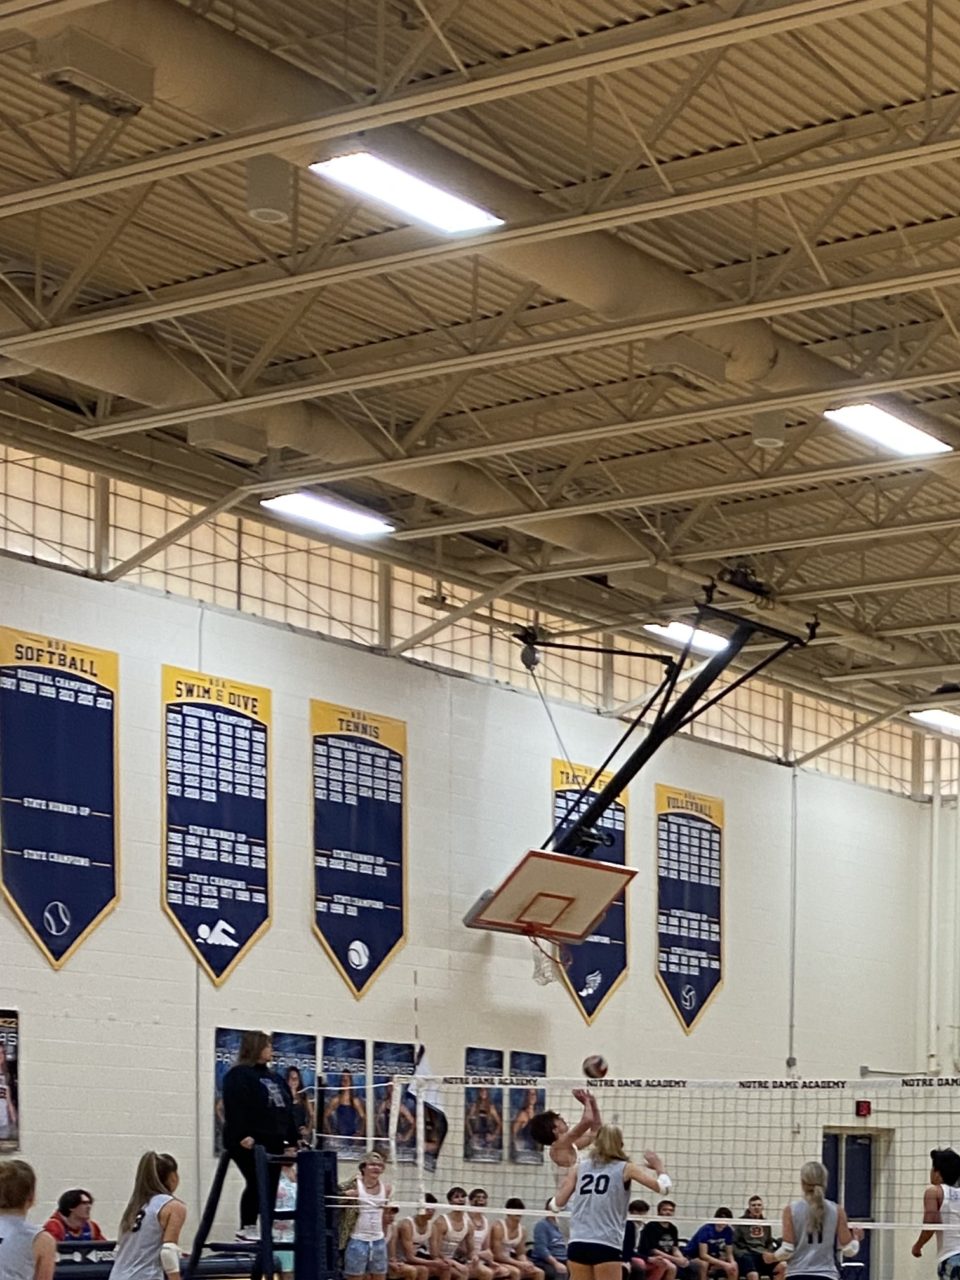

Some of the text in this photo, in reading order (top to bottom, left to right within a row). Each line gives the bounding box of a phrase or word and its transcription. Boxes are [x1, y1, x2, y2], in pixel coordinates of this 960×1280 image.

[14, 643, 98, 677] SOFTBALL
[175, 680, 211, 699] SWIM
[228, 692, 259, 715] DIVE
[337, 718, 380, 739] TENNIS
[666, 796, 713, 819] VOLLEYBALL
[587, 1079, 615, 1087] NOTRE
[644, 1080, 687, 1088] ACADEMY
[739, 1080, 847, 1089] NOTRE DAME ACADEMY
[901, 1078, 934, 1087] NOTRE
[580, 1174, 610, 1195] 20
